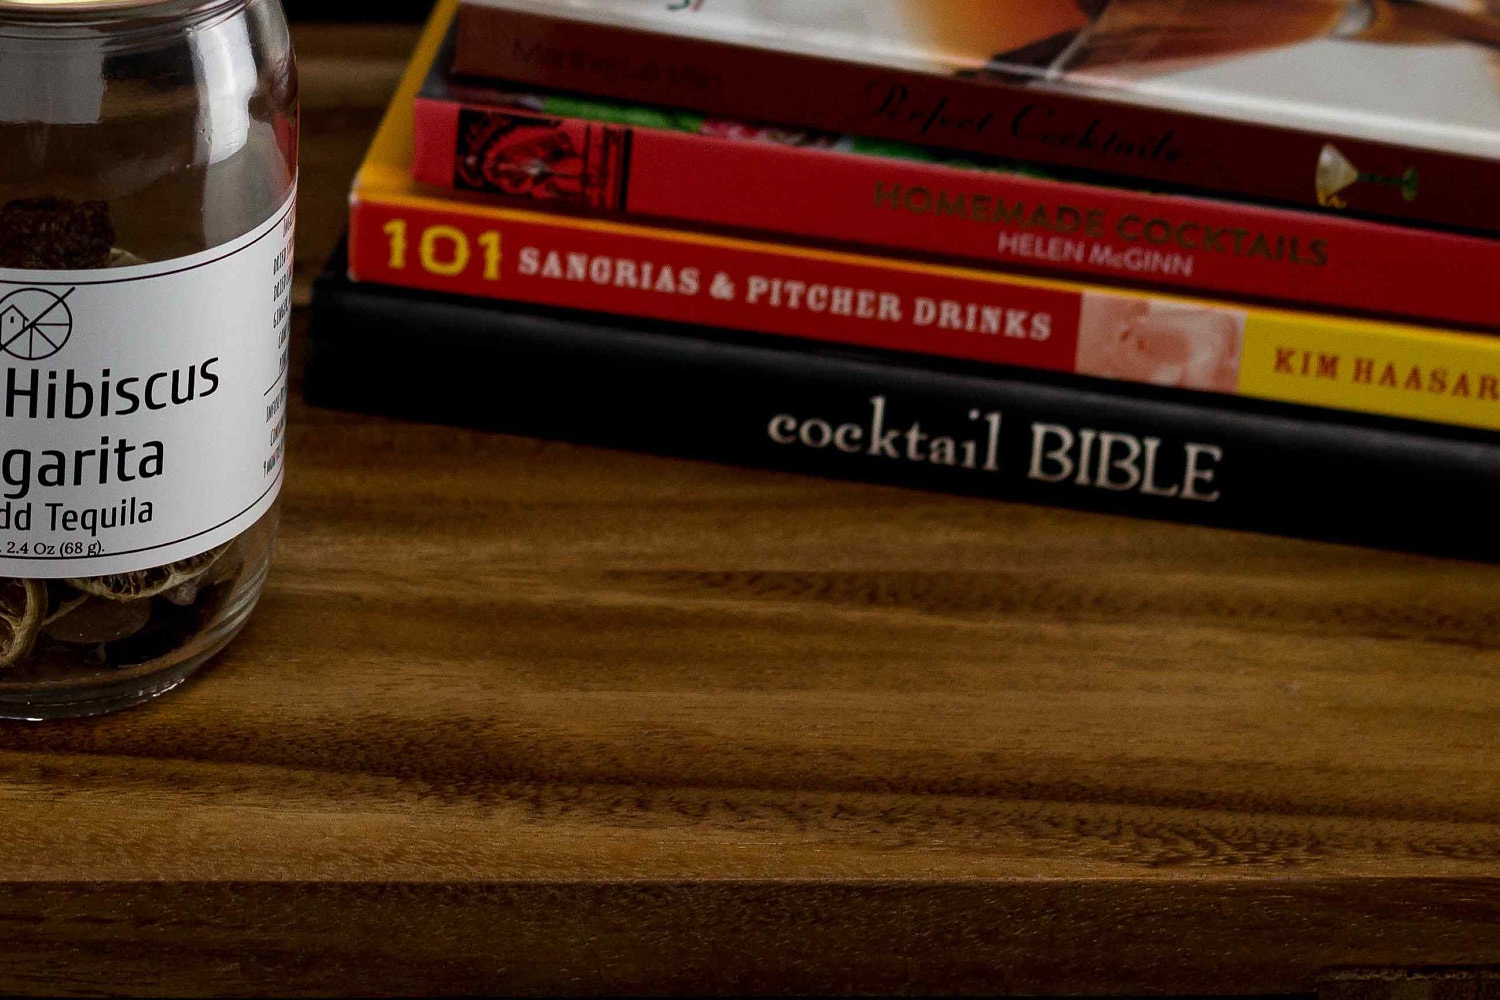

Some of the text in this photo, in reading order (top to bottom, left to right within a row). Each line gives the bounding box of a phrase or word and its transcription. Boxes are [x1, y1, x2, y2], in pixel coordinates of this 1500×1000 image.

[872, 180, 1329, 268] HOMEMADE COCKTAILS
[384, 218, 1053, 341] 101 SANGRIAS & PITCHER DRINKS
[998, 230, 1194, 278] HELEN McGINN
[5, 356, 219, 420] Hibiscus
[1273, 346, 1340, 381] KIM
[768, 395, 1224, 503] cocktail BIBLE
[45, 496, 154, 537] Tequila
[6, 541, 29, 554] 2.4
[33, 543, 55, 555] Oz
[59, 541, 83, 557] (68
